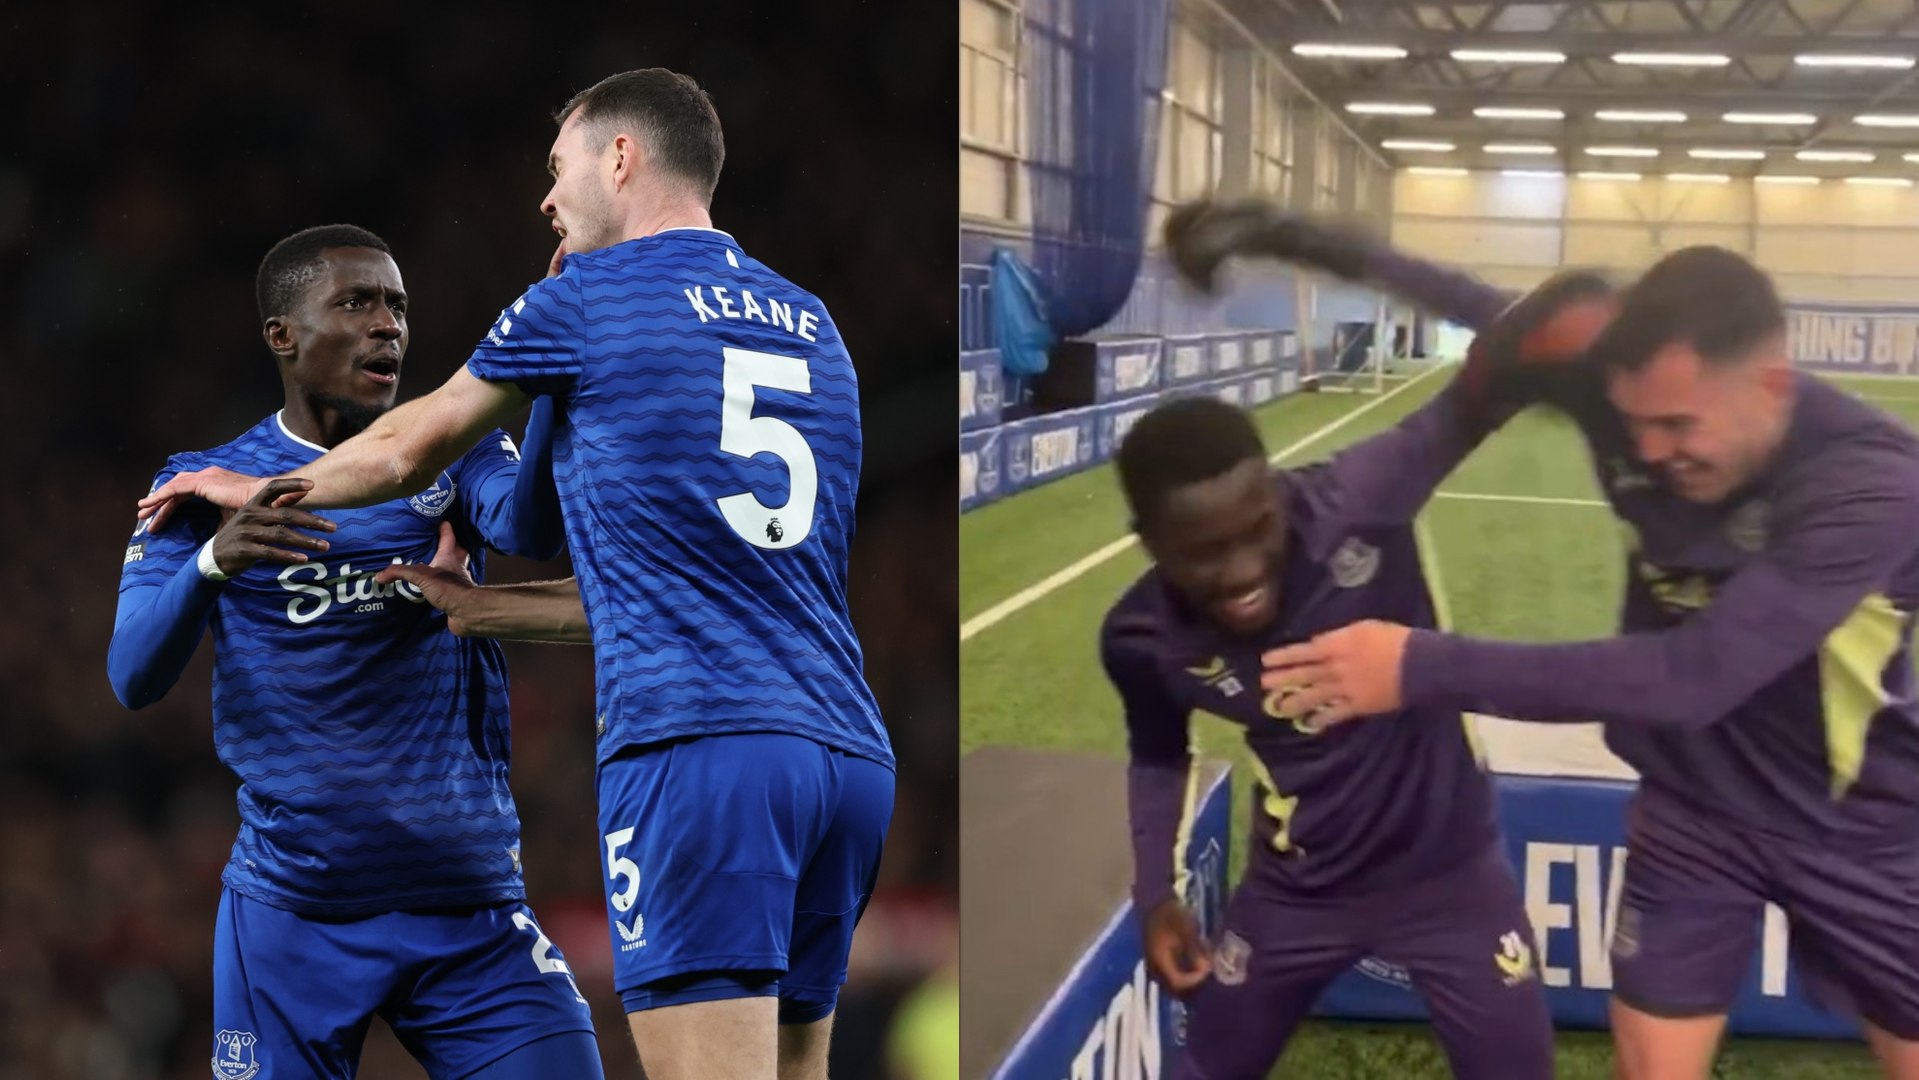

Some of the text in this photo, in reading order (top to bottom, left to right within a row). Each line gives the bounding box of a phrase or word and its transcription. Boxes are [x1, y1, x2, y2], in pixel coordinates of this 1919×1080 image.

[684, 286, 819, 343] KEANE
[716, 346, 818, 550] 5
[421, 489, 449, 503] Everton
[354, 602, 384, 613] .com
[605, 826, 641, 912] 5
[220, 1059, 247, 1070] Everton
